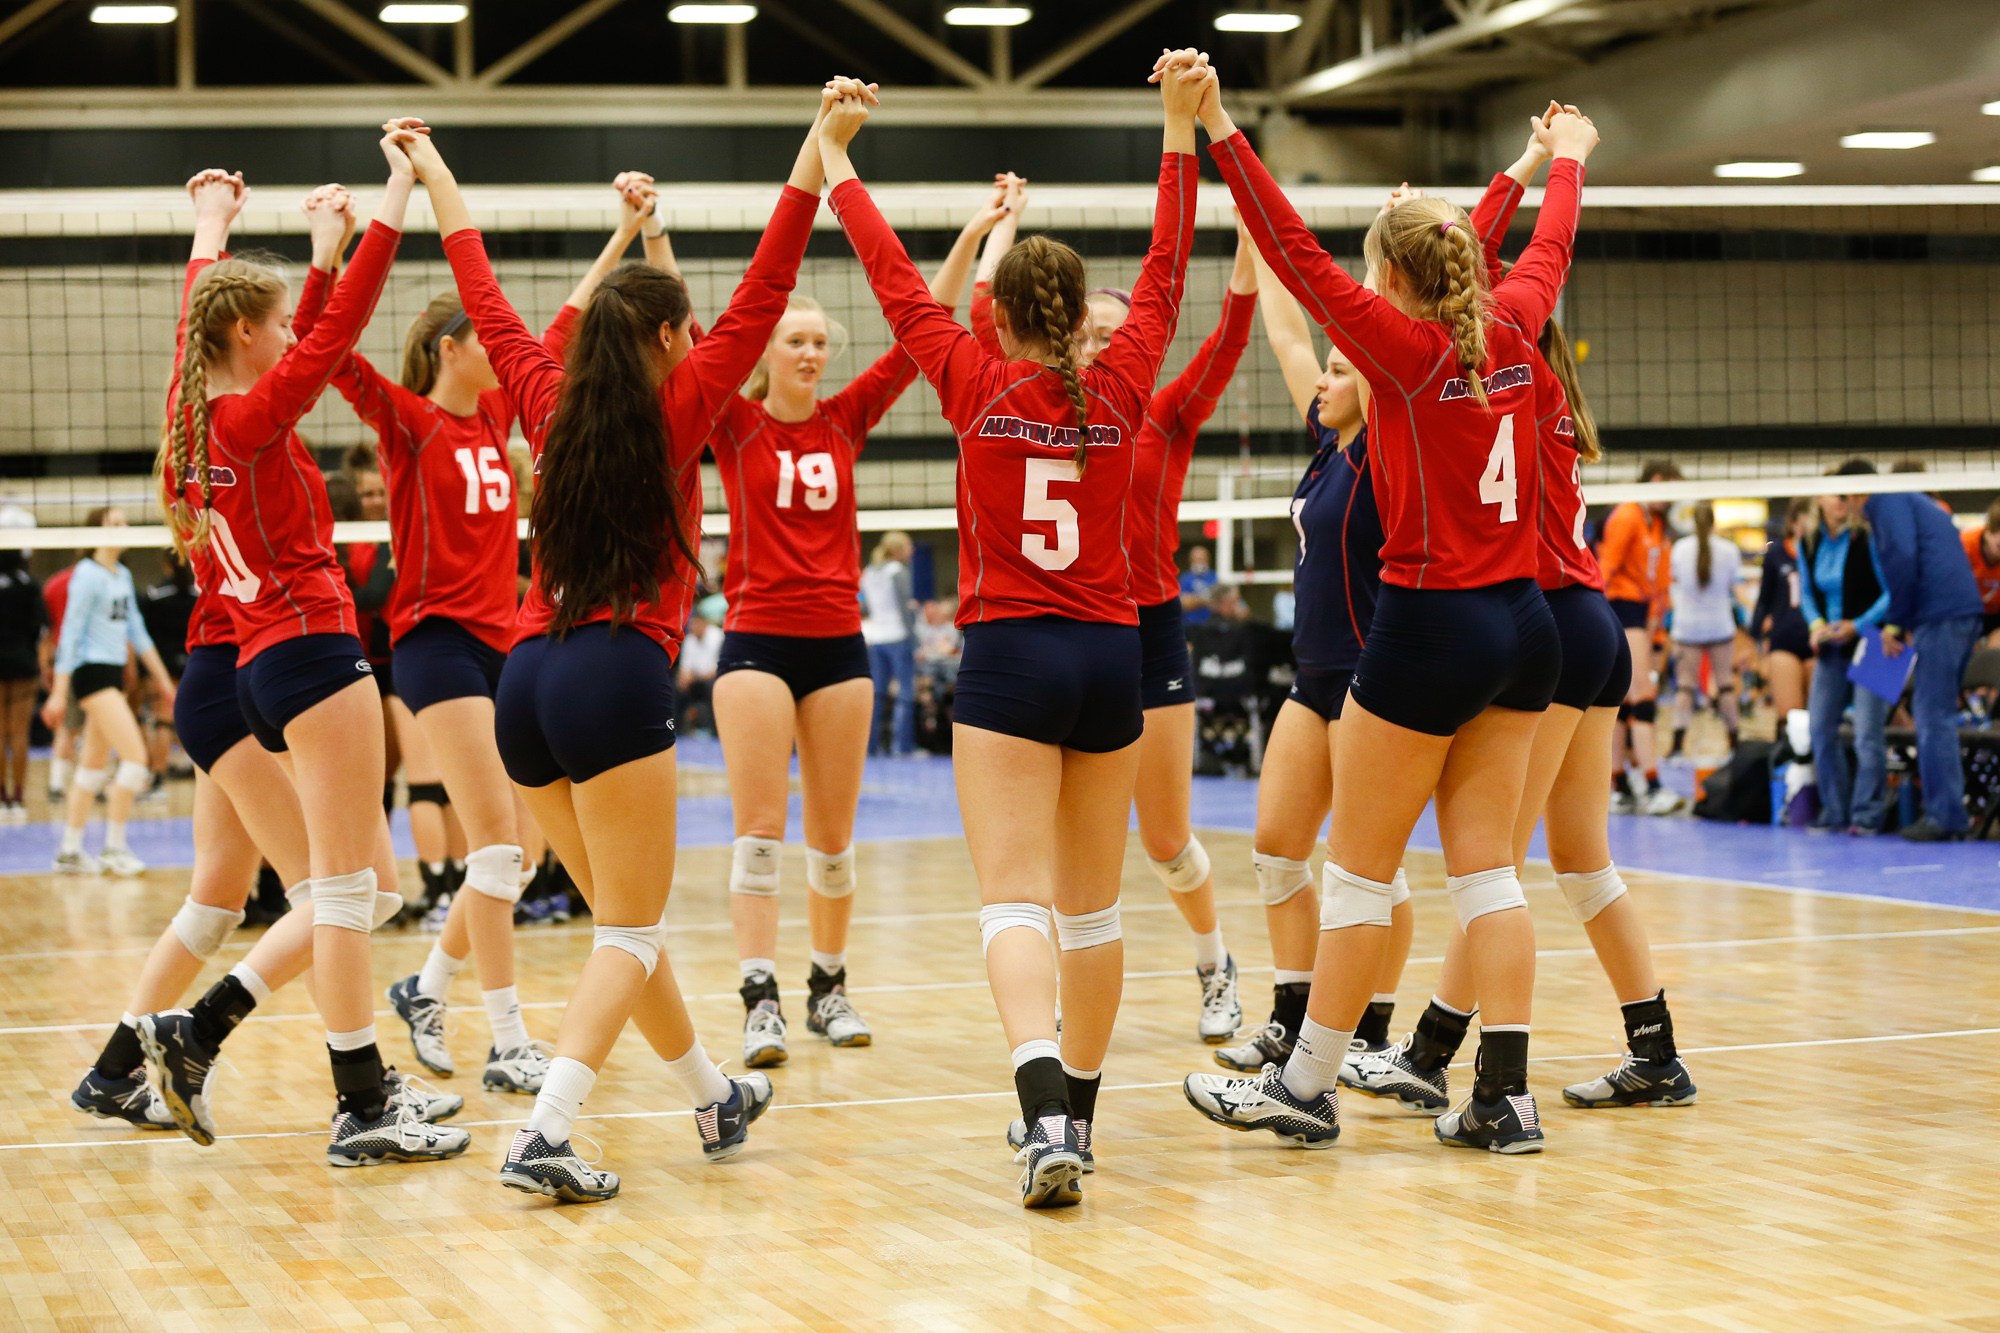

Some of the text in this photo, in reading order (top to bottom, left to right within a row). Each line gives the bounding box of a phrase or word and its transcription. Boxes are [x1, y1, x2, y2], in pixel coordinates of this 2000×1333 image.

[979, 415, 1052, 446] AUSTIN
[455, 447, 511, 514] 15
[775, 450, 838, 511] 19
[1479, 413, 1518, 523] 4
[1021, 458, 1081, 571] 5
[1633, 1023, 1663, 1037] ZAMST
